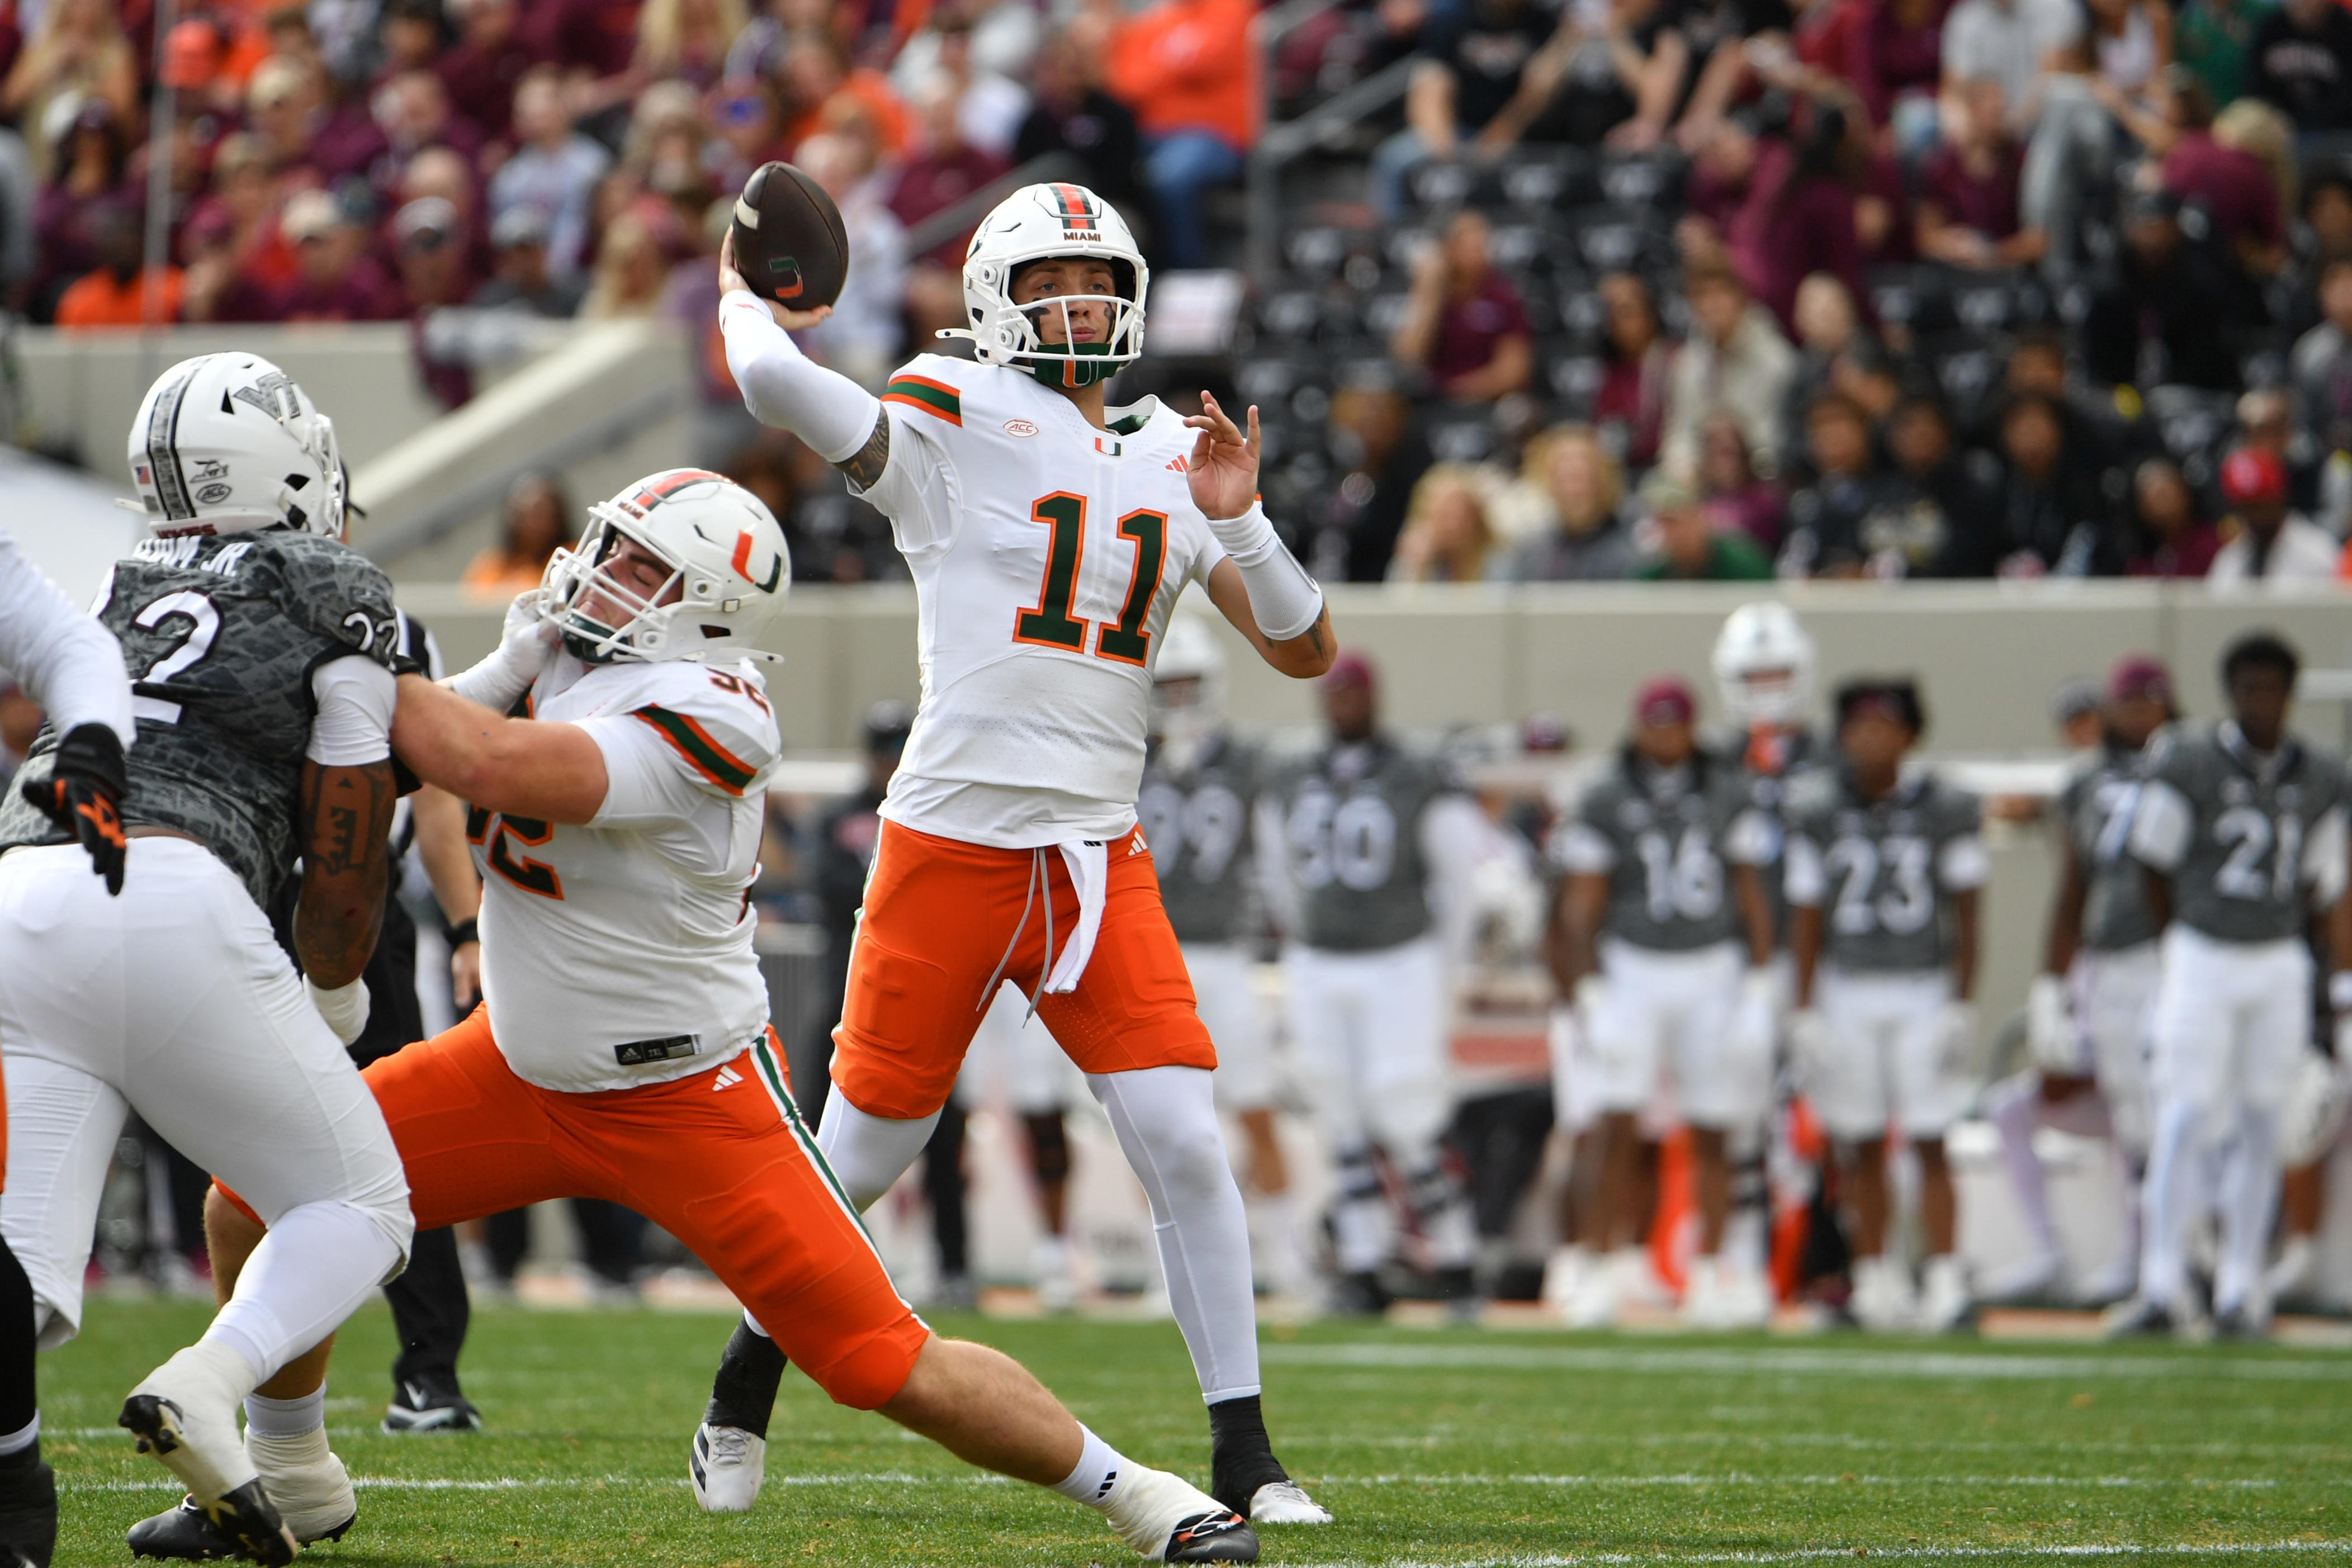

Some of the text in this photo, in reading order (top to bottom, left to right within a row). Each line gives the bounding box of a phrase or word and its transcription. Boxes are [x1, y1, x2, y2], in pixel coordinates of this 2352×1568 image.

[1063, 232, 1101, 241] MIAMI
[1009, 423, 1034, 433] ACC
[1094, 437, 1121, 457] U
[731, 529, 782, 594] U
[1012, 490, 1168, 668] 11
[1635, 828, 1724, 922] 16
[1824, 835, 1936, 936] 23
[2212, 806, 2303, 902] 21
